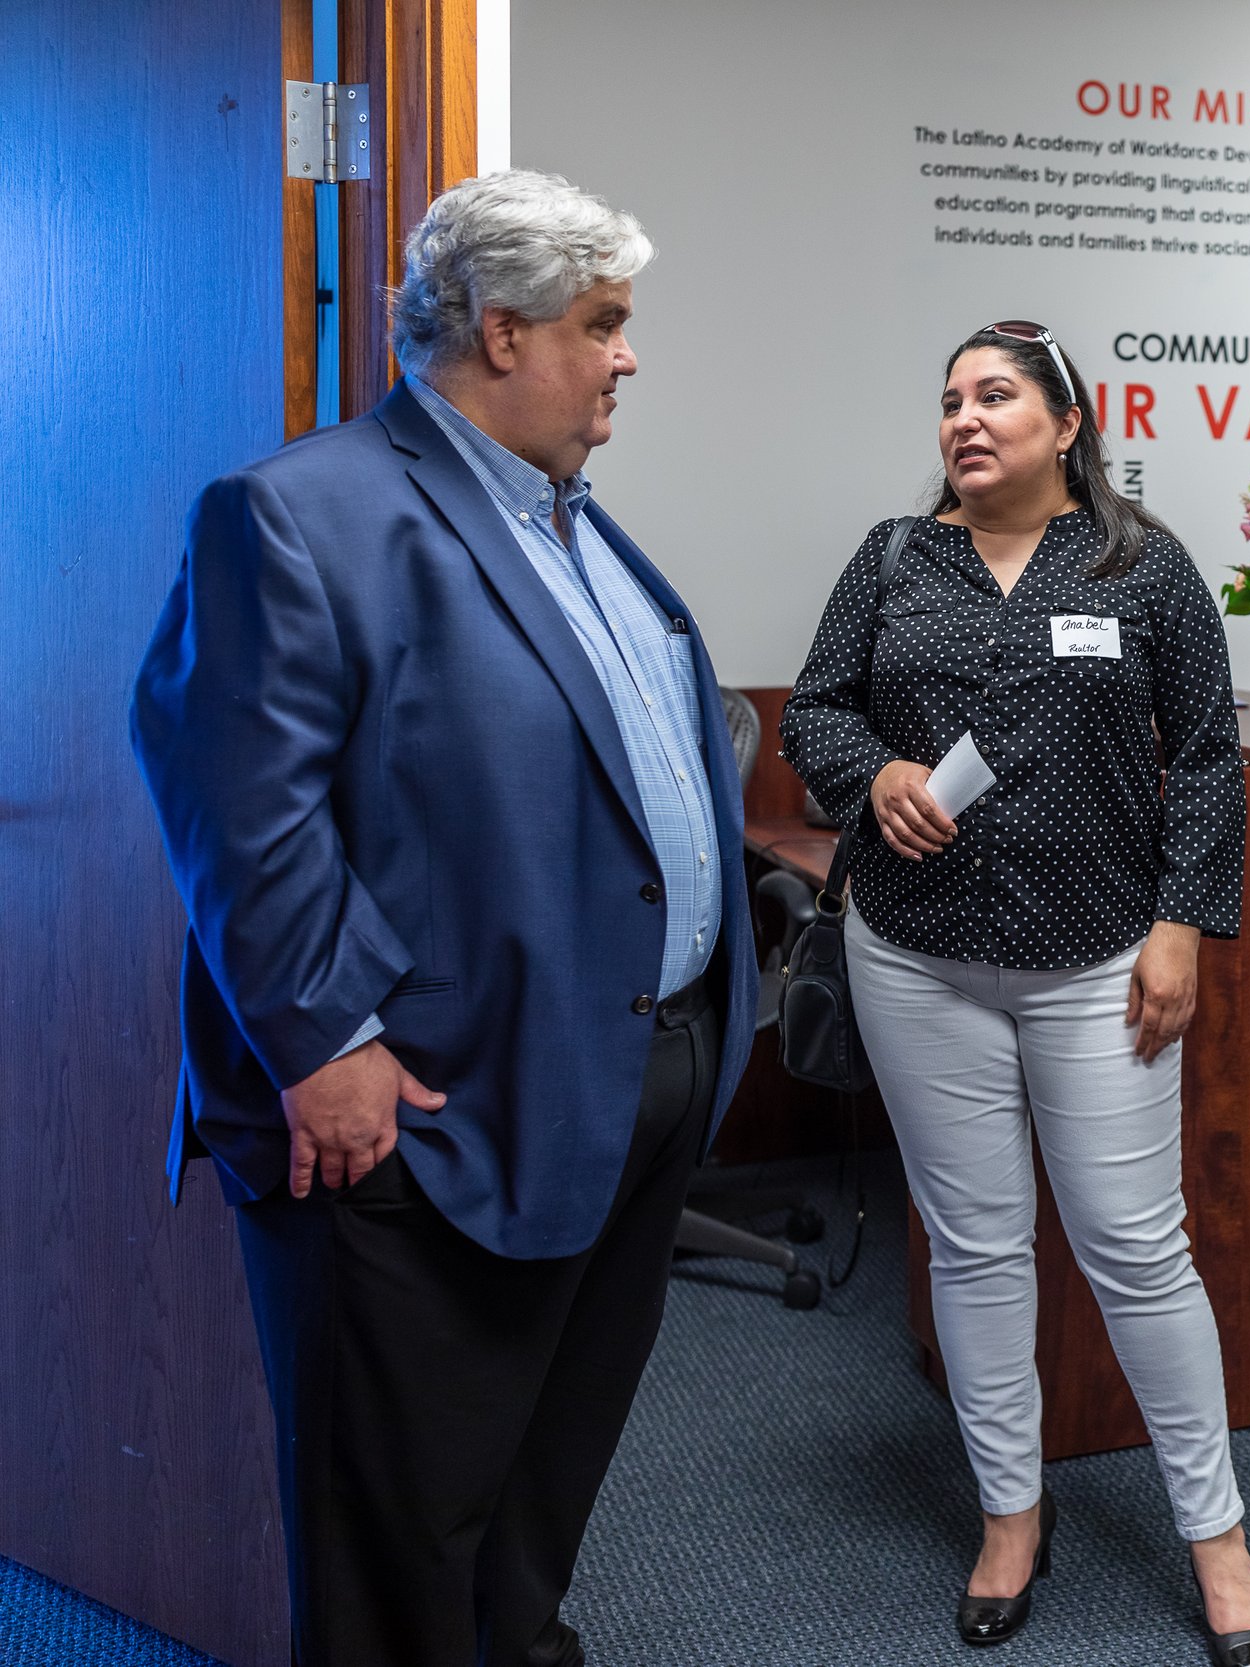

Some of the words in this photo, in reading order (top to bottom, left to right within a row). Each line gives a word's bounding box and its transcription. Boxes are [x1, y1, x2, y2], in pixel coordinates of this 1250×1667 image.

[1077, 80, 1171, 120] OUR
[914, 126, 947, 145] The
[952, 128, 1008, 149] Latino
[1013, 133, 1103, 157] Academy
[1108, 138, 1127, 156] of
[1130, 139, 1218, 162] Workforce
[920, 161, 1040, 183] communities
[1044, 166, 1068, 187] by
[1072, 170, 1157, 192] providing
[934, 195, 1030, 214] education
[1035, 201, 1157, 224] programming
[1161, 206, 1196, 222] that
[934, 226, 1034, 247] individuals
[1038, 231, 1074, 249] and
[1079, 233, 1147, 252] families
[1151, 237, 1198, 255] thrive
[1068, 643, 1101, 653] Realtor
